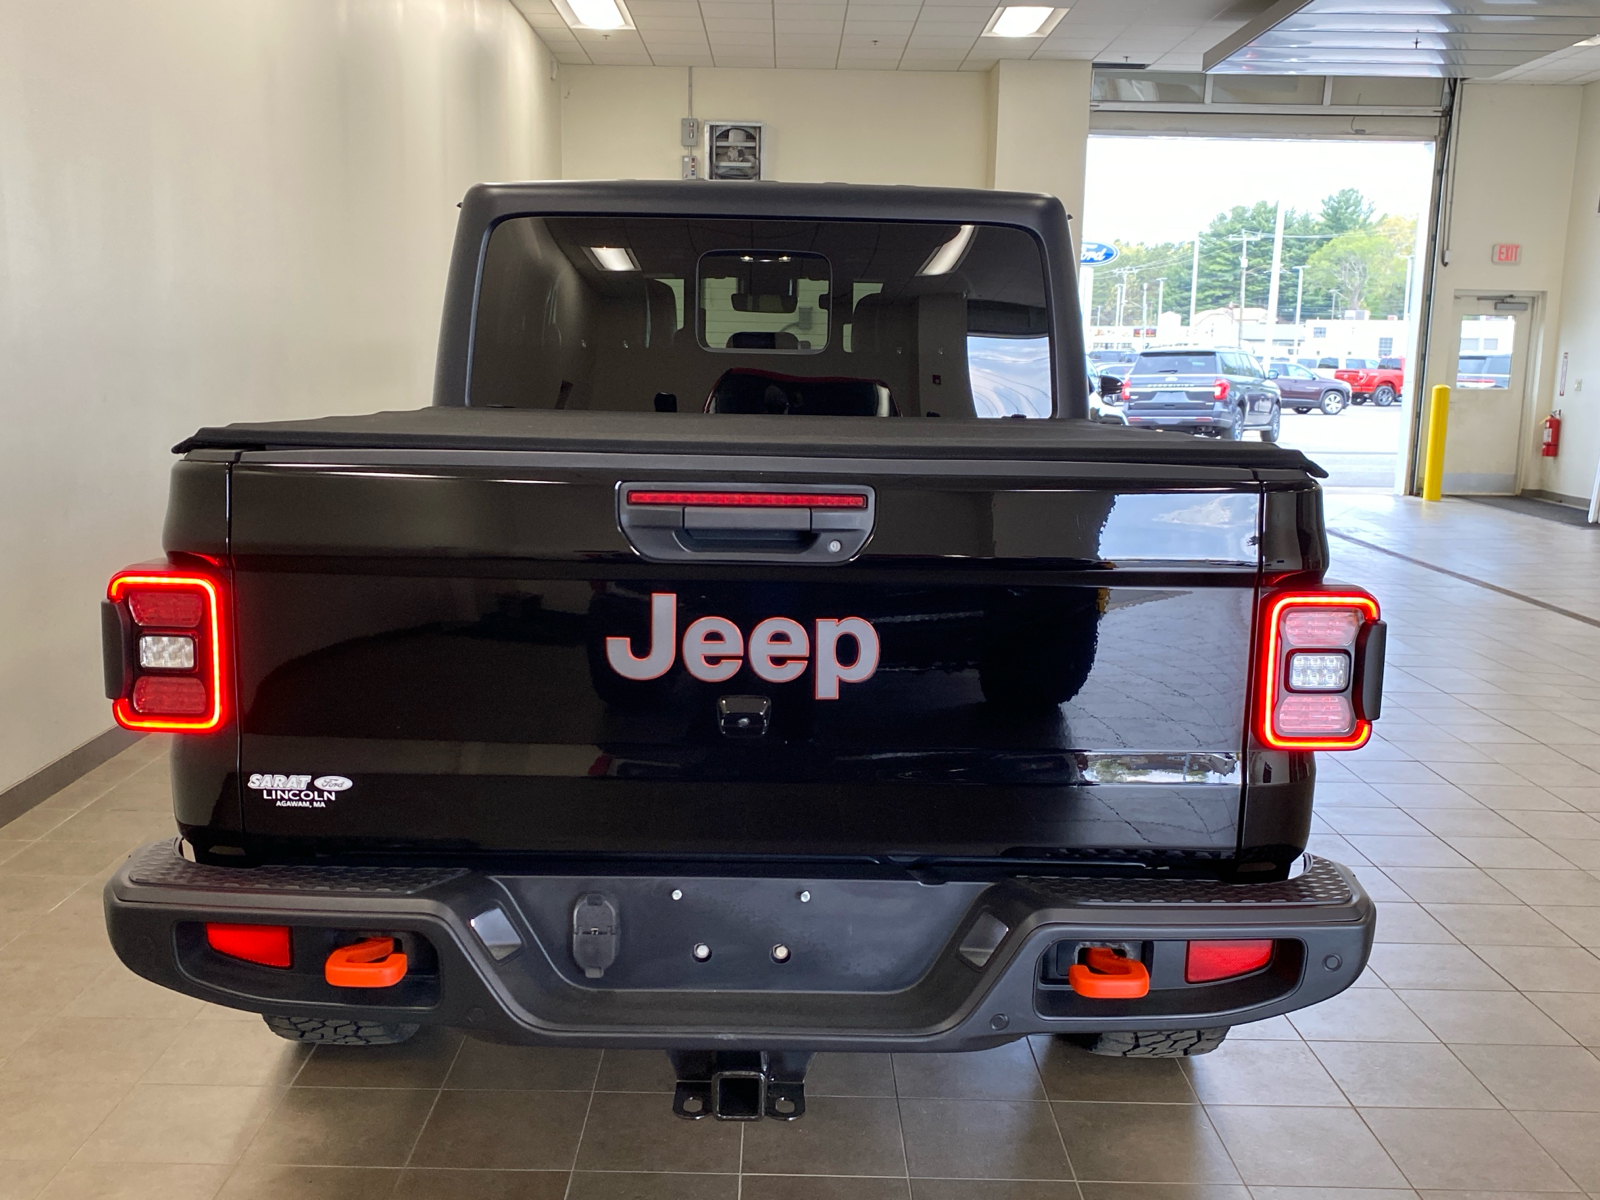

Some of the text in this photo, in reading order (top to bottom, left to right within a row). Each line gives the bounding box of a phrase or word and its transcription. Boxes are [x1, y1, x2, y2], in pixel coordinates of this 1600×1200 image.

[1498, 244, 1520, 261] EXIT
[605, 592, 880, 700] Jeep
[247, 773, 312, 790] SARAT
[263, 790, 336, 801] LINCOLN
